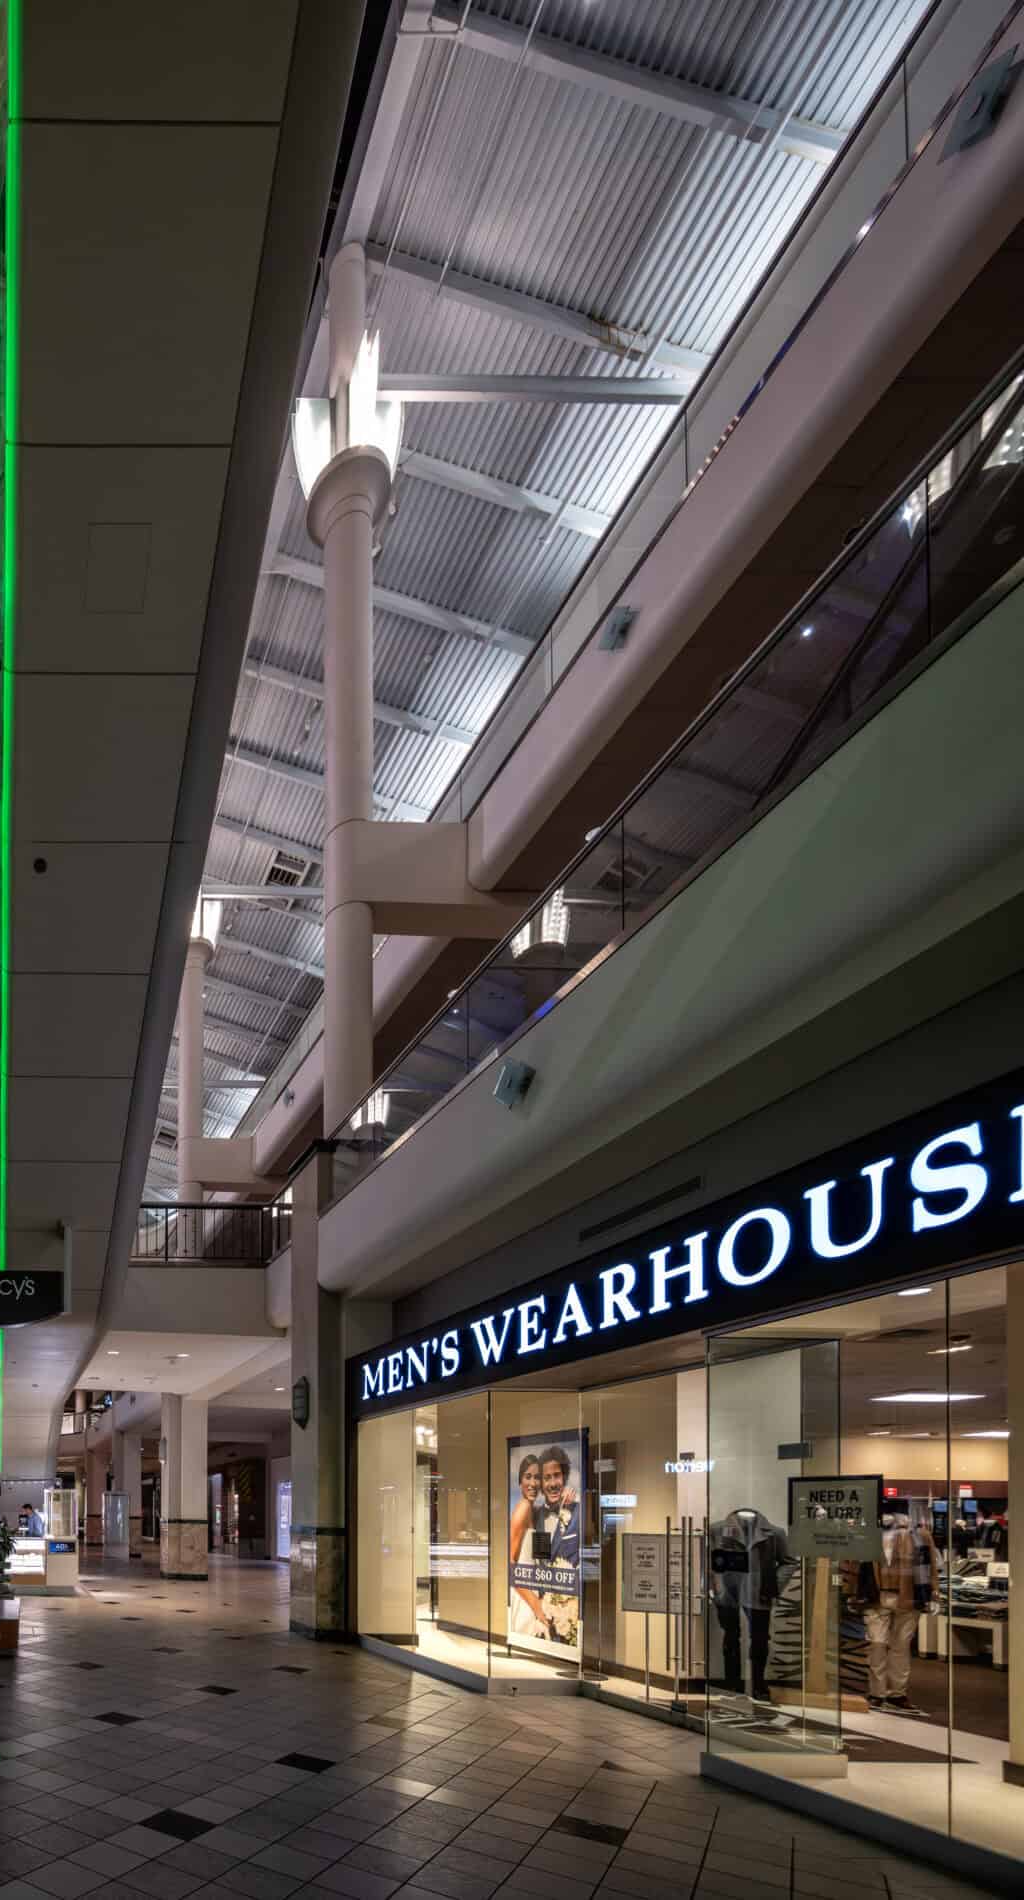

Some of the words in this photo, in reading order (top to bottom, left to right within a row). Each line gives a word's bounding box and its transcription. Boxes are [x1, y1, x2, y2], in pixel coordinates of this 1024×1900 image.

[362, 1329, 460, 1401] MEN'S
[470, 1104, 1024, 1367] WEARHOUS
[809, 1489, 845, 1503] NEED
[849, 1489, 859, 1502] A
[806, 1506, 862, 1519] TLOR?
[514, 1567, 533, 1578] GET
[535, 1568, 552, 1581] $60
[555, 1571, 575, 1584] OFF
